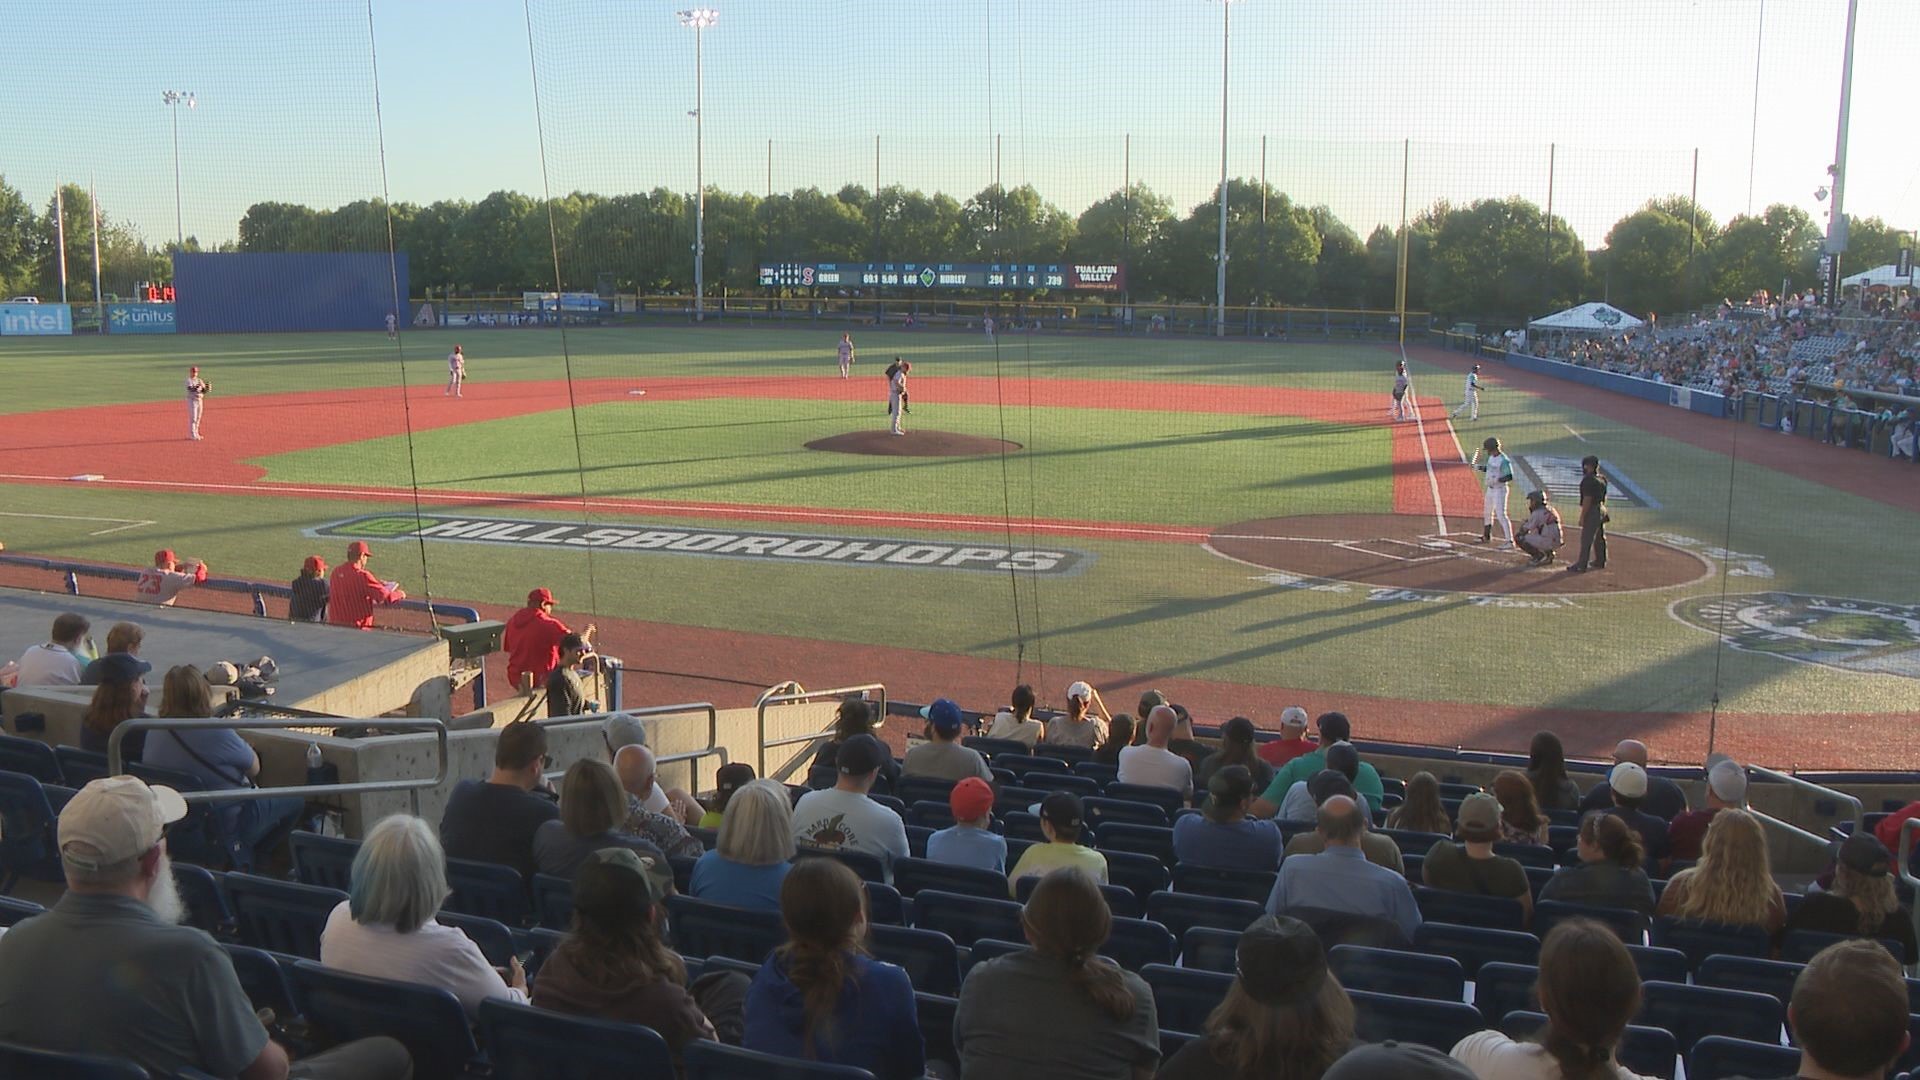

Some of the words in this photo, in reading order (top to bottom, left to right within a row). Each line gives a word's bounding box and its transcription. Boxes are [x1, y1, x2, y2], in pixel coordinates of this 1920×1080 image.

[1074, 265, 1117, 273] TUALATIN
[1079, 273, 1112, 282] VALLEY
[4, 308, 64, 332] intel
[132, 310, 174, 323] unitus
[838, 822, 859, 847] CORE
